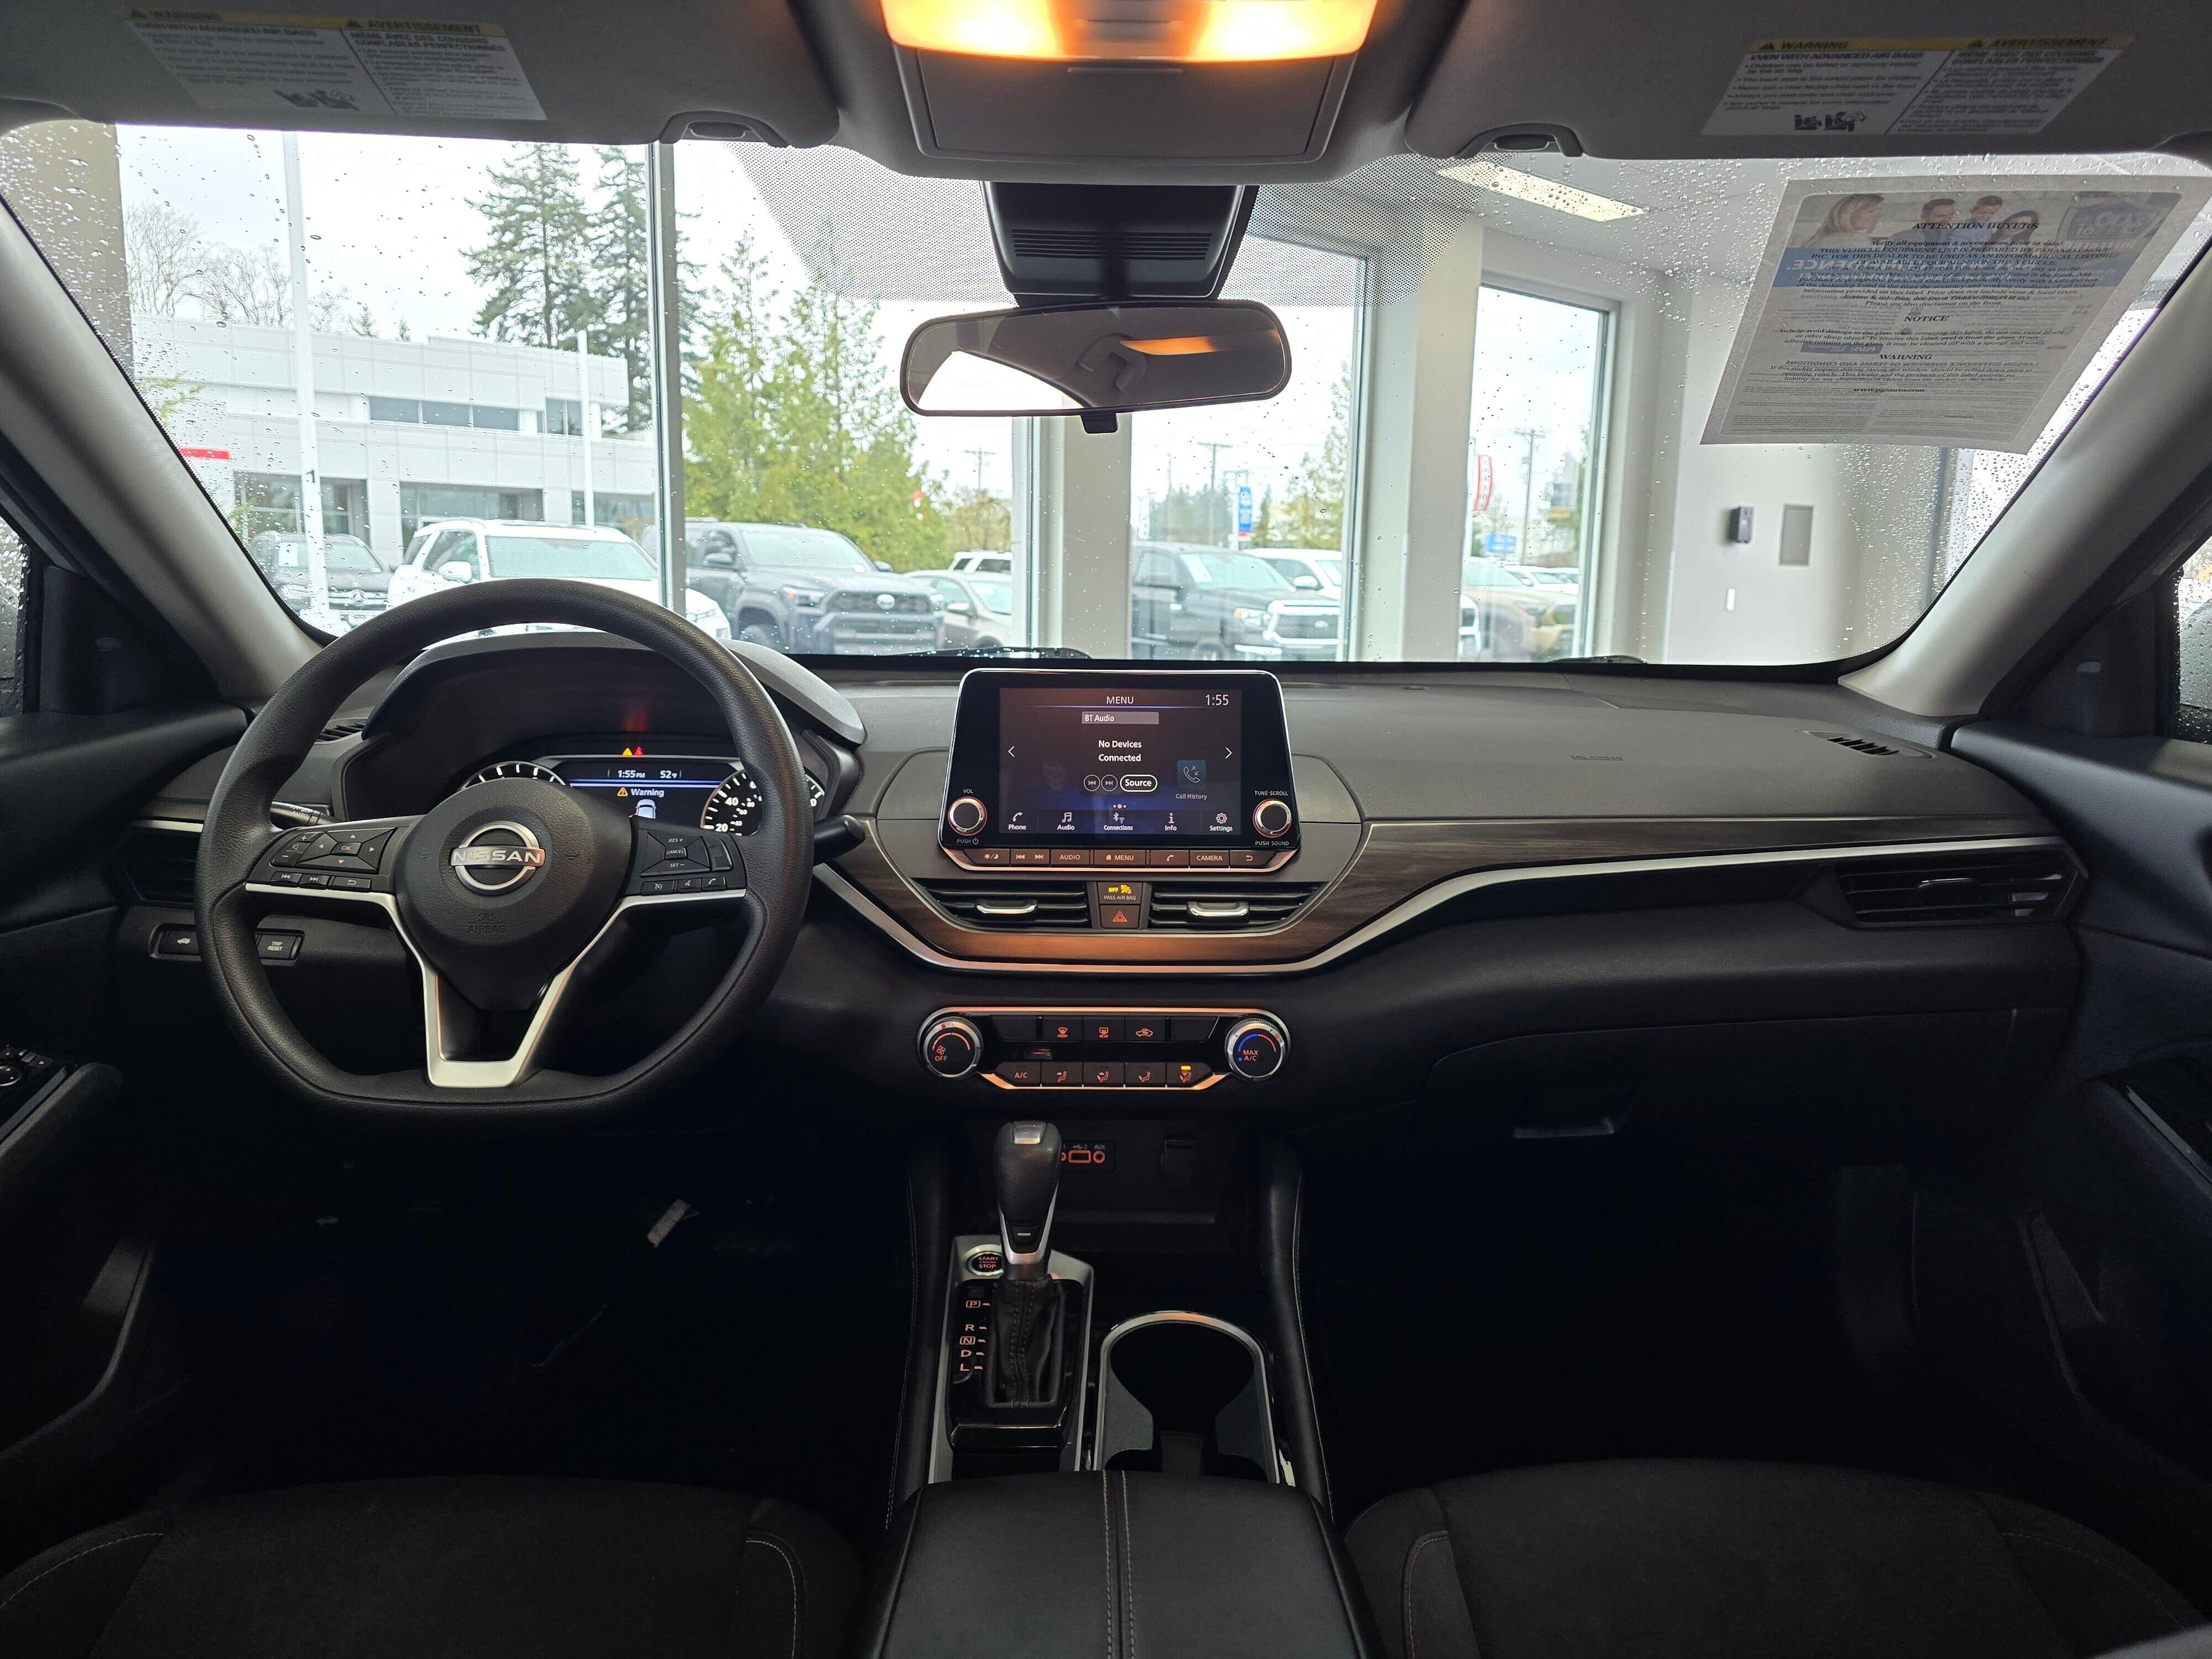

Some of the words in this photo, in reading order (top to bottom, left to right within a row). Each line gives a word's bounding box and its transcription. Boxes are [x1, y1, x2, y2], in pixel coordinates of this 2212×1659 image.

[368, 20, 481, 33] AVERTISSEMENT
[1106, 696, 1134, 705] MENU
[1205, 694, 1229, 706] 1:55
[1084, 714, 1093, 722] BT
[1094, 714, 1115, 722] Audio
[1098, 740, 1110, 748] No
[1112, 740, 1142, 748] Devices
[1098, 753, 1142, 762] Connected
[1125, 779, 1152, 787] Source
[631, 788, 664, 797] Warning
[725, 797, 739, 806] 40
[715, 823, 728, 832] 20
[453, 849, 541, 863] NISSAN
[961, 1349, 972, 1358] D
